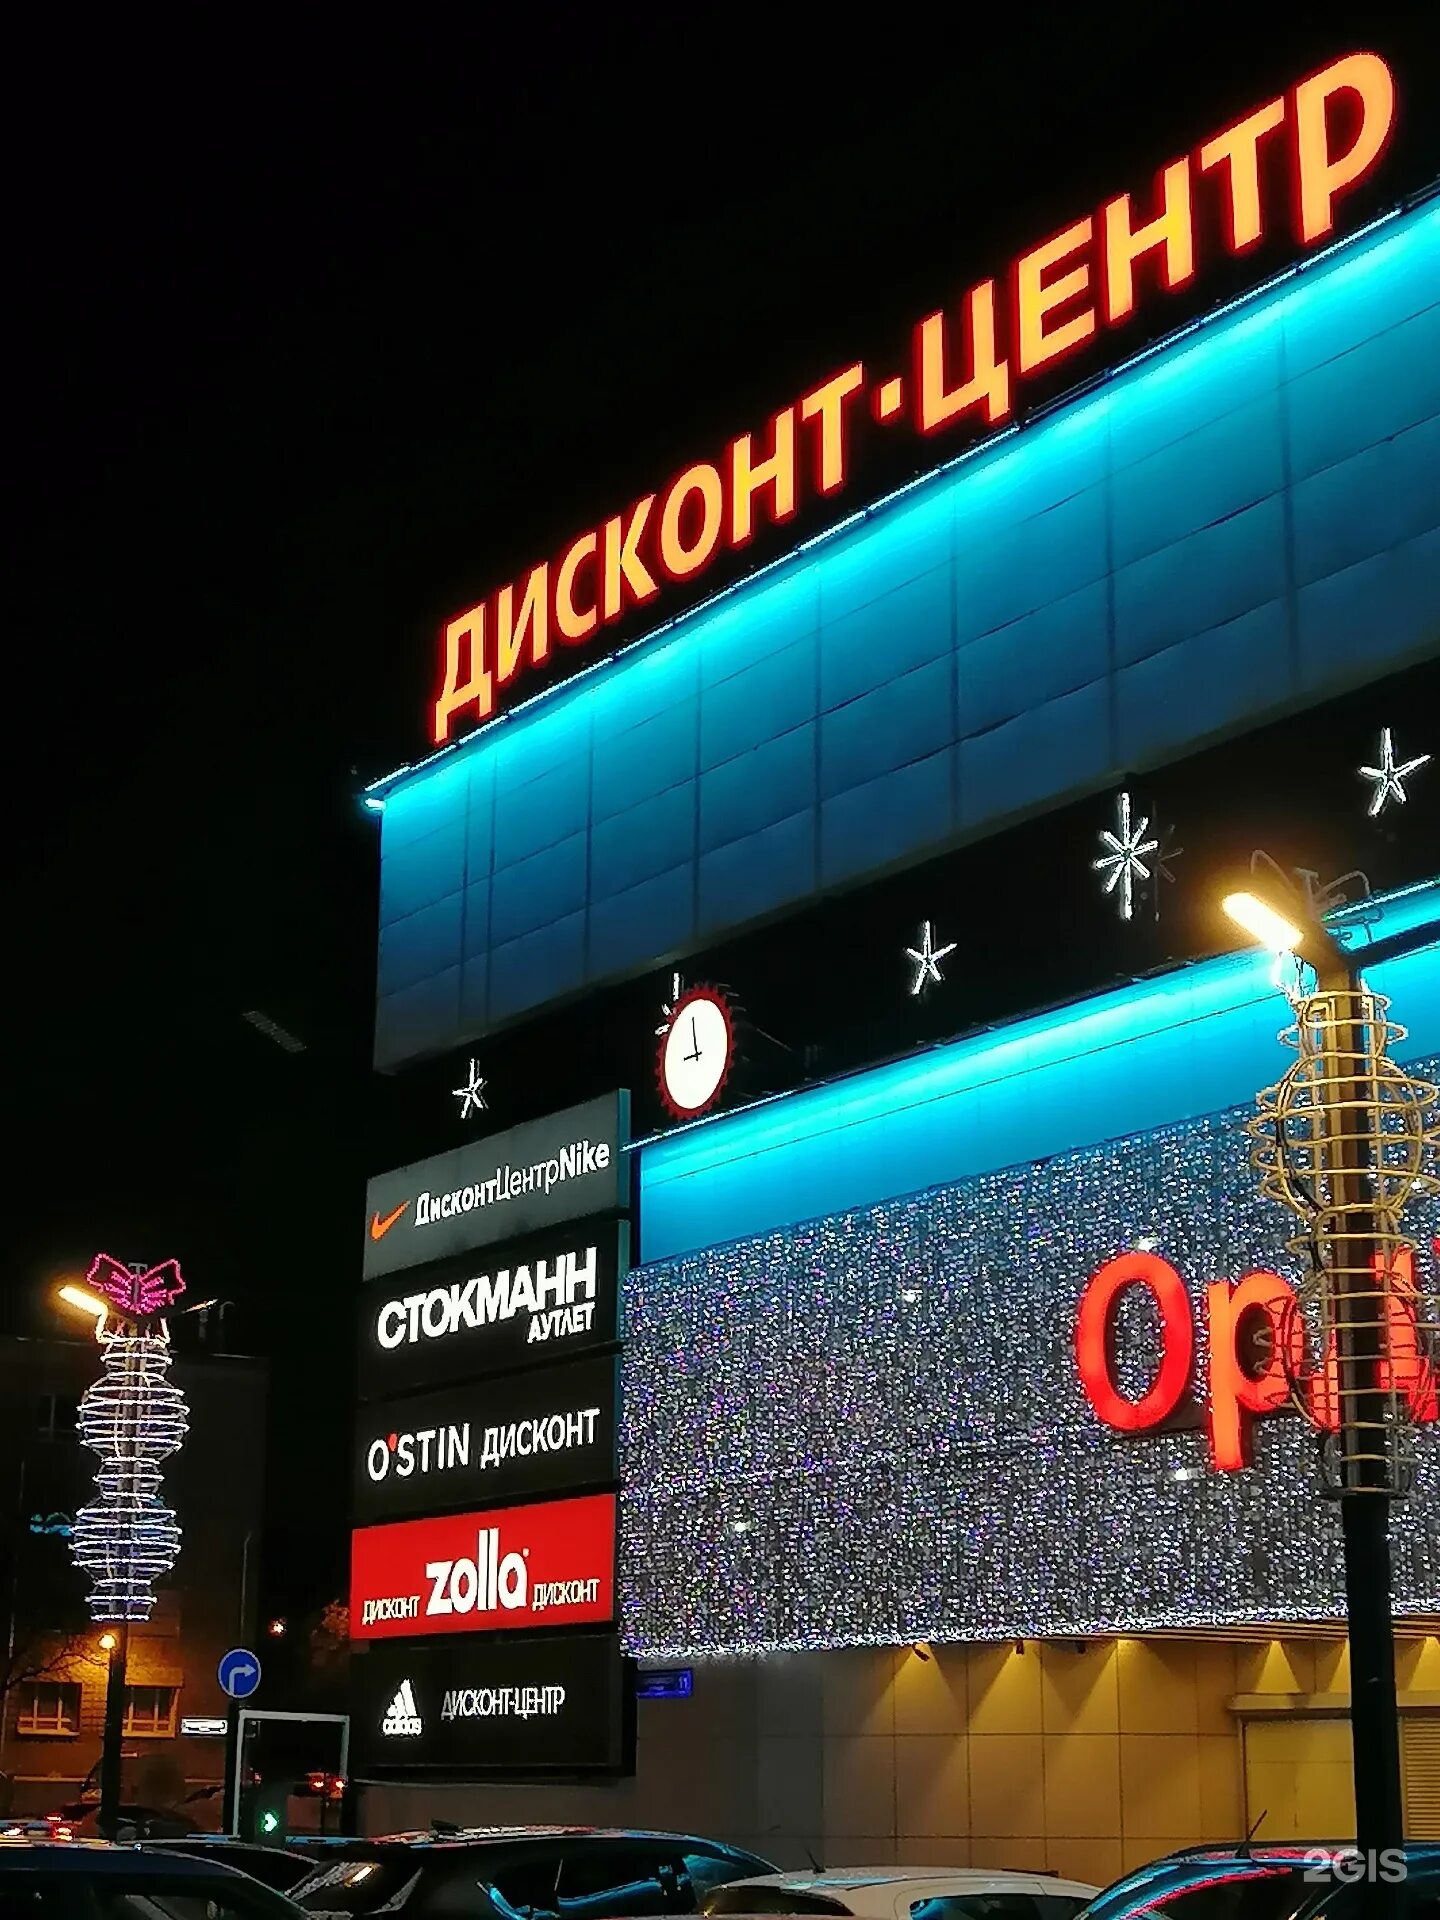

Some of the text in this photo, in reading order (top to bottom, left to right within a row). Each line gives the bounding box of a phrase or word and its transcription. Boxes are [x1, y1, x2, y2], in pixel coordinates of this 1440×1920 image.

[377, 1246, 597, 1349] СТОКМАНН
[527, 1301, 596, 1344] АУТЛЕТ
[367, 1407, 601, 1481] O'STIN ДИСКОНТ
[362, 1527, 601, 1626] ДИСКОНТ zolla ДИСКОНТ
[441, 1685, 566, 1721] ДИСКОНТ-ЦЕНТР
